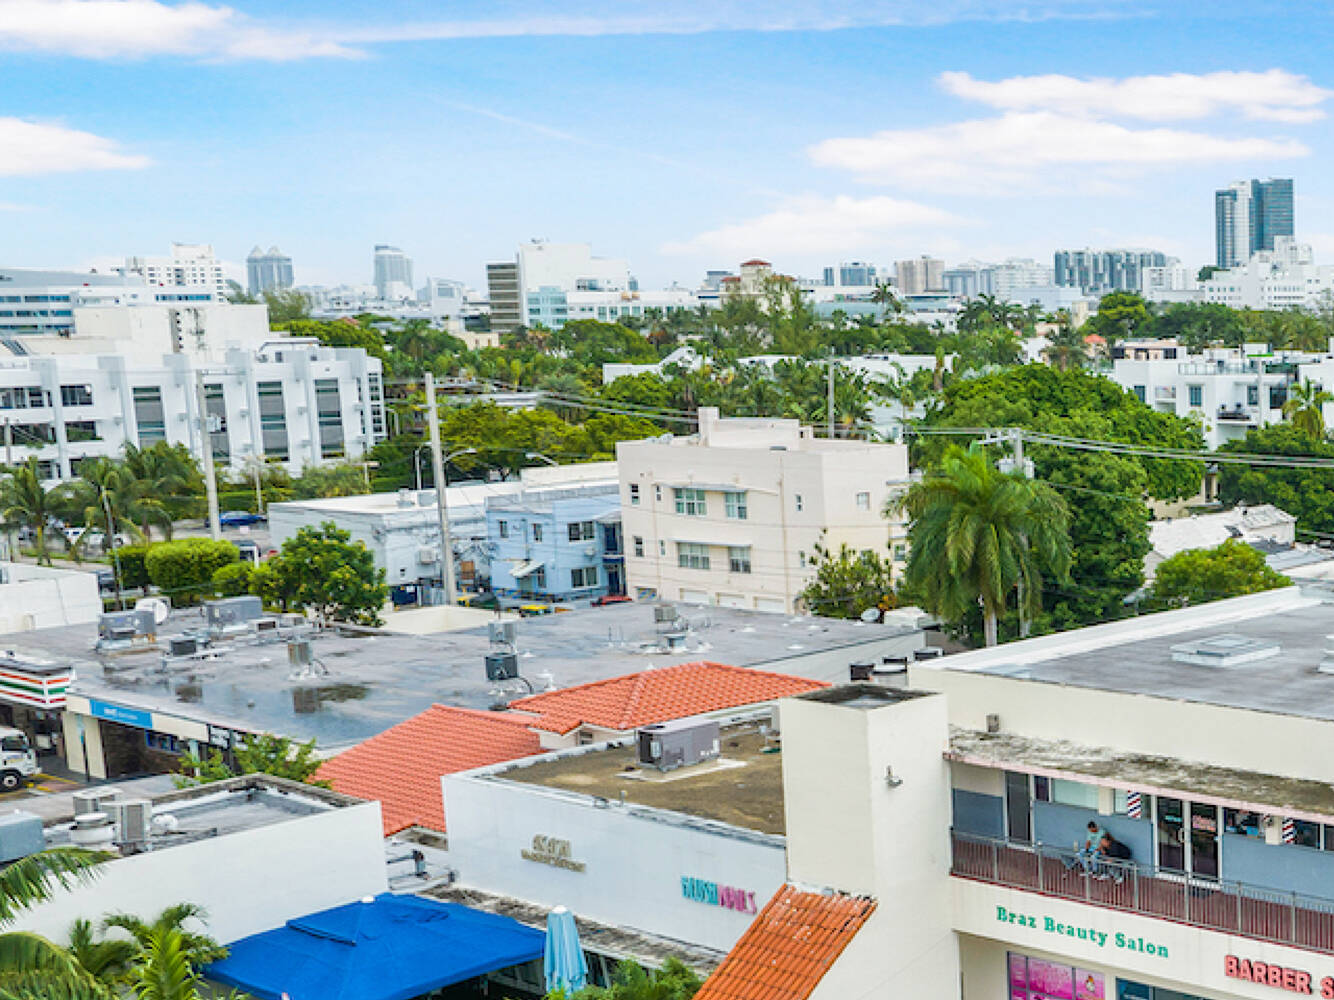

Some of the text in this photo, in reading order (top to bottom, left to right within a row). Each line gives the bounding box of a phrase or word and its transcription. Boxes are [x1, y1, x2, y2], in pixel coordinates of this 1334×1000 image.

[996, 905, 1169, 958] Braz Beauty Salon
[1224, 954, 1313, 995] BARBER
